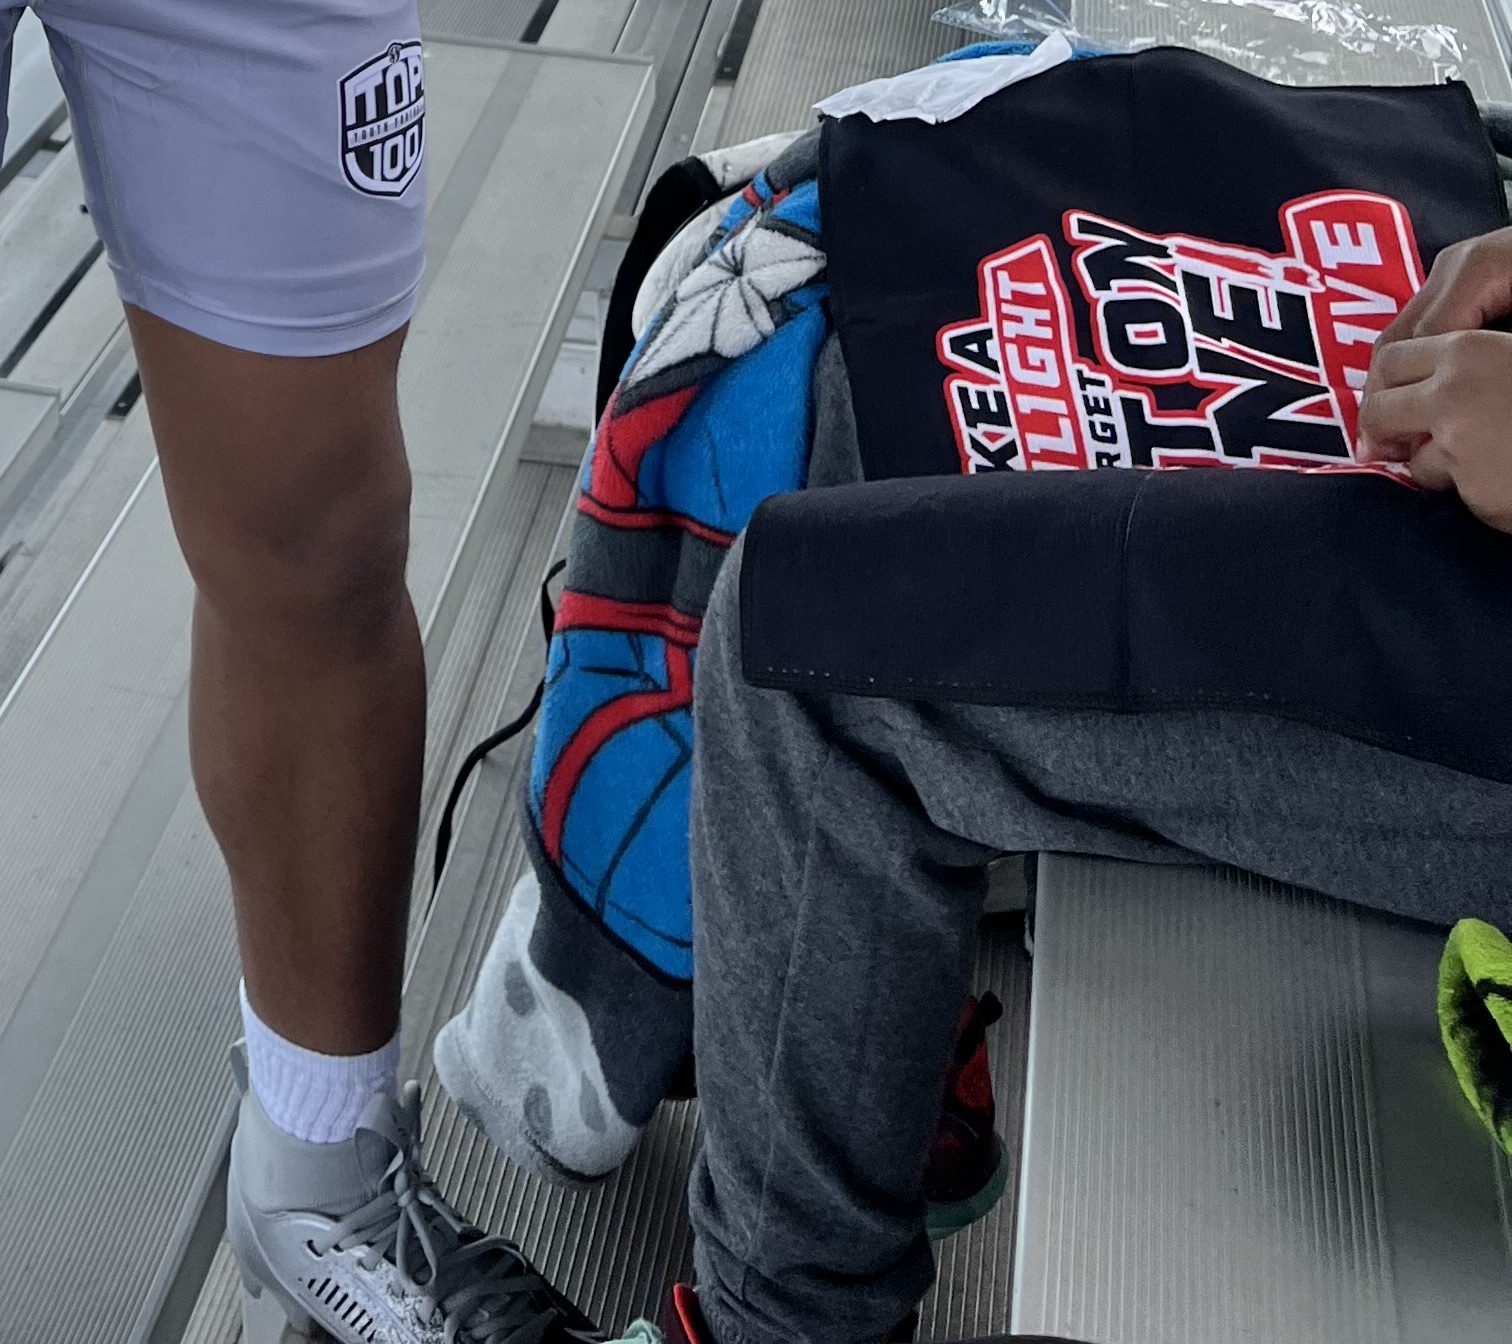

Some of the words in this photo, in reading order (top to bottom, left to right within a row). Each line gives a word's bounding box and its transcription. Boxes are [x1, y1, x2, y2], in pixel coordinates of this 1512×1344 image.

[345, 53, 424, 126] TOP
[369, 124, 420, 182] 100
[996, 269, 1086, 470] LIGHT
